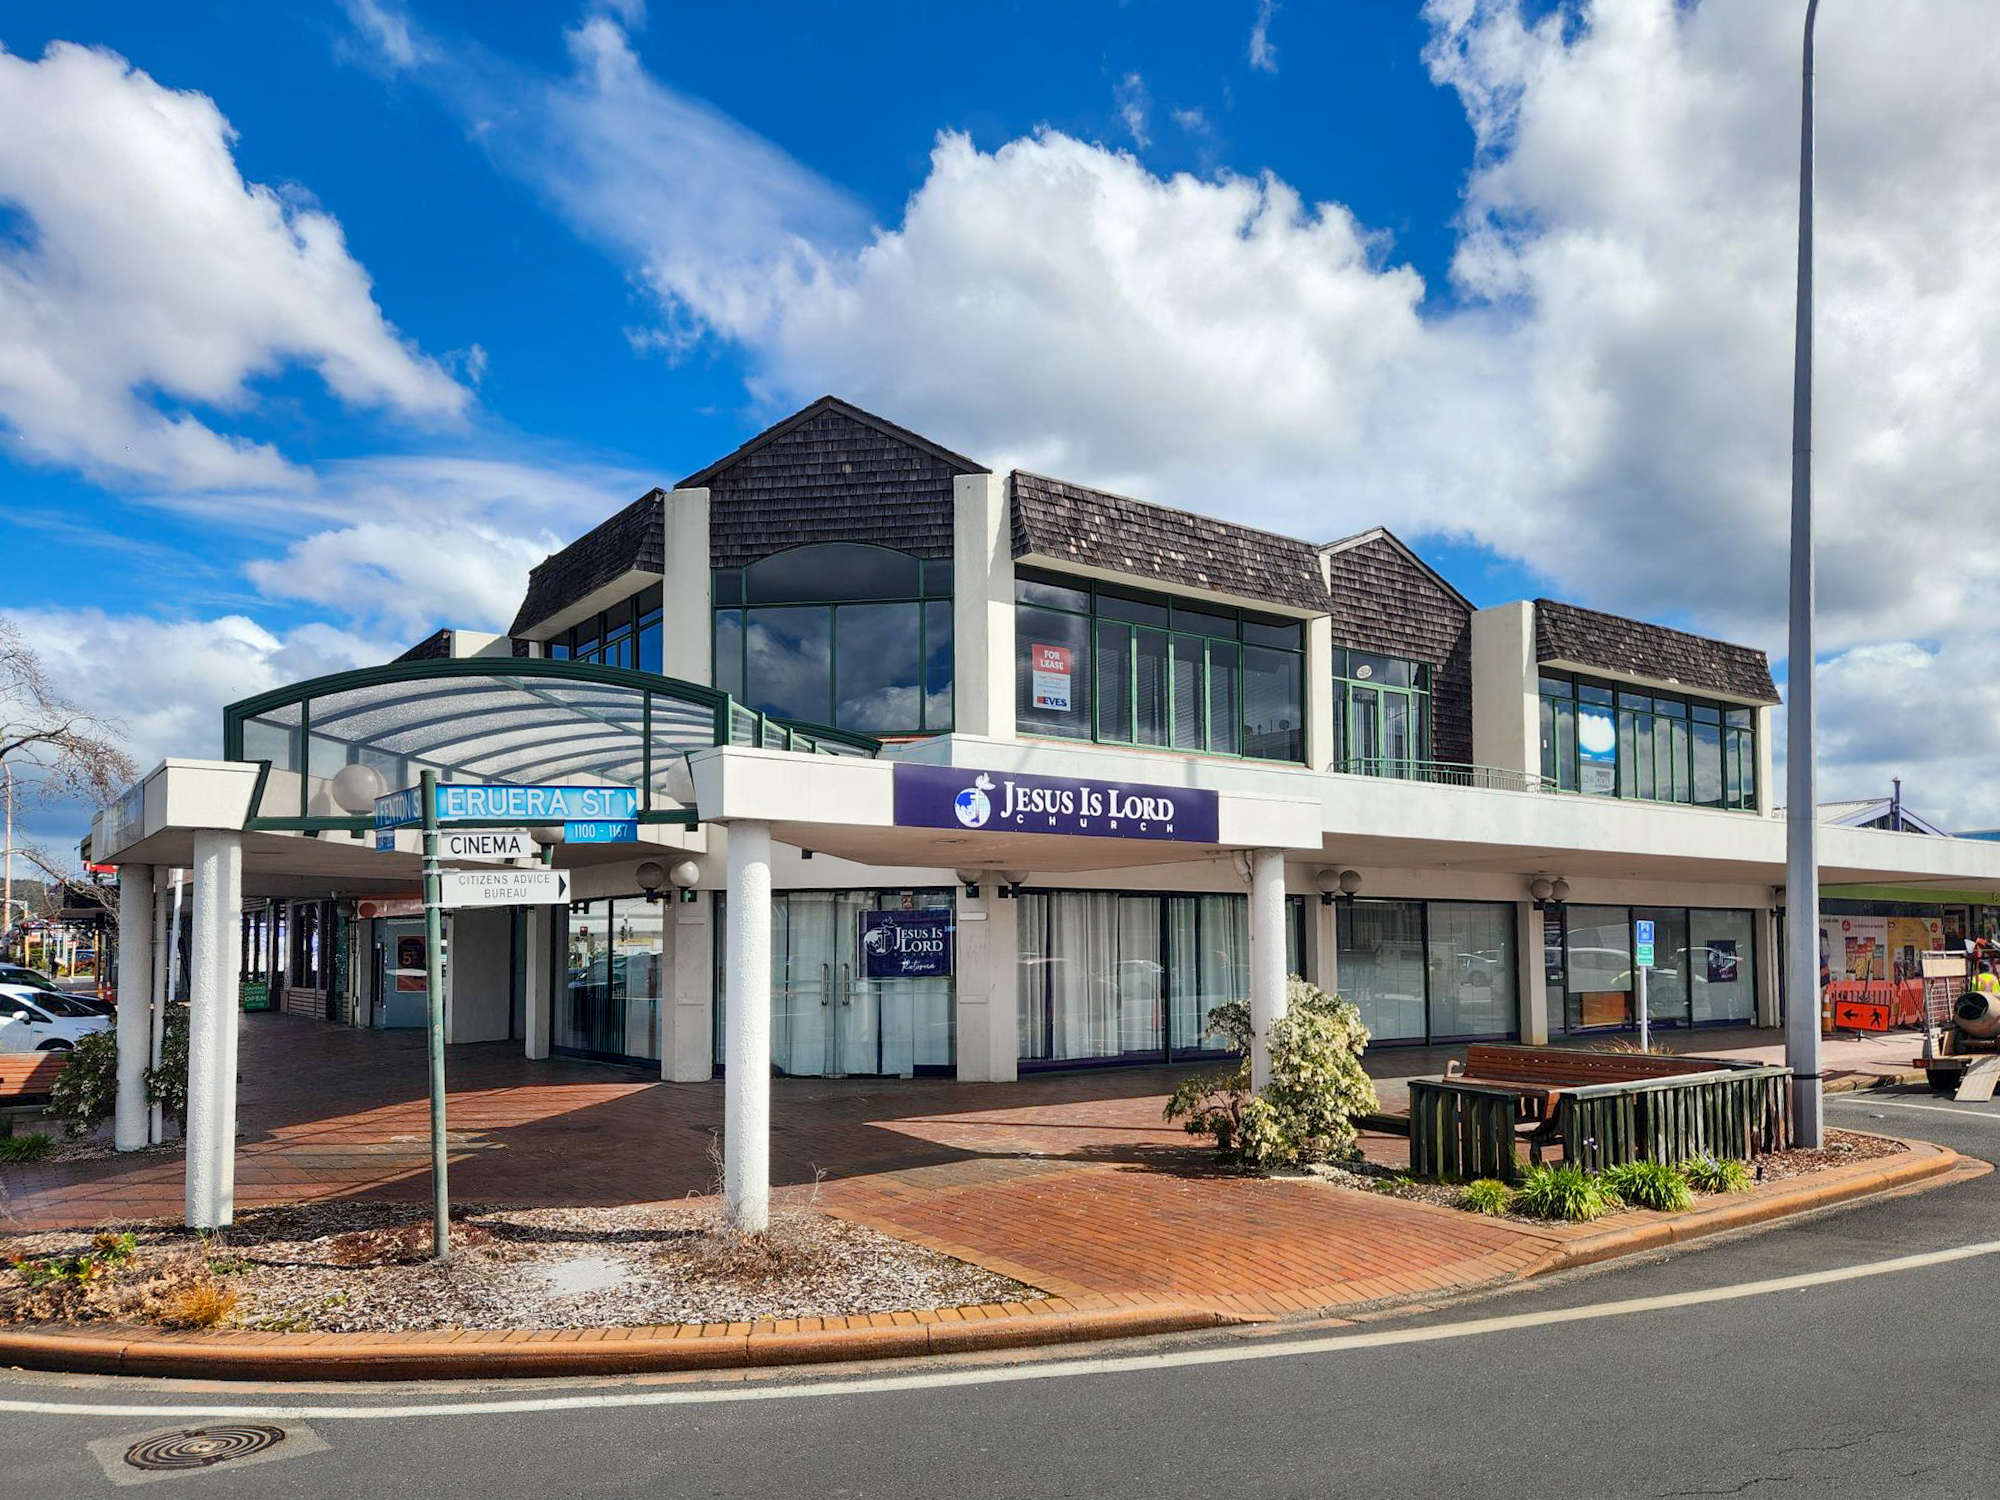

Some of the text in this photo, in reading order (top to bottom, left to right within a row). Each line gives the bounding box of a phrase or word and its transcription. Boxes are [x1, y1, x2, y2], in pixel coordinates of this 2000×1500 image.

[1044, 650, 1060, 660] FOR
[1040, 660, 1064, 670] LEASE
[1043, 697, 1067, 707] EVES
[447, 787, 616, 816] ERUERA ST
[380, 792, 411, 826] FENTON
[574, 824, 596, 838] 1100
[609, 823, 628, 837] 1167
[1016, 815, 1174, 833] CHURCH
[450, 835, 521, 855] CINEMA
[458, 873, 551, 886] CITIZENS ADVICE
[484, 887, 527, 899] BUREAU
[894, 926, 928, 949] JESUS
[900, 939, 944, 953] LORD
